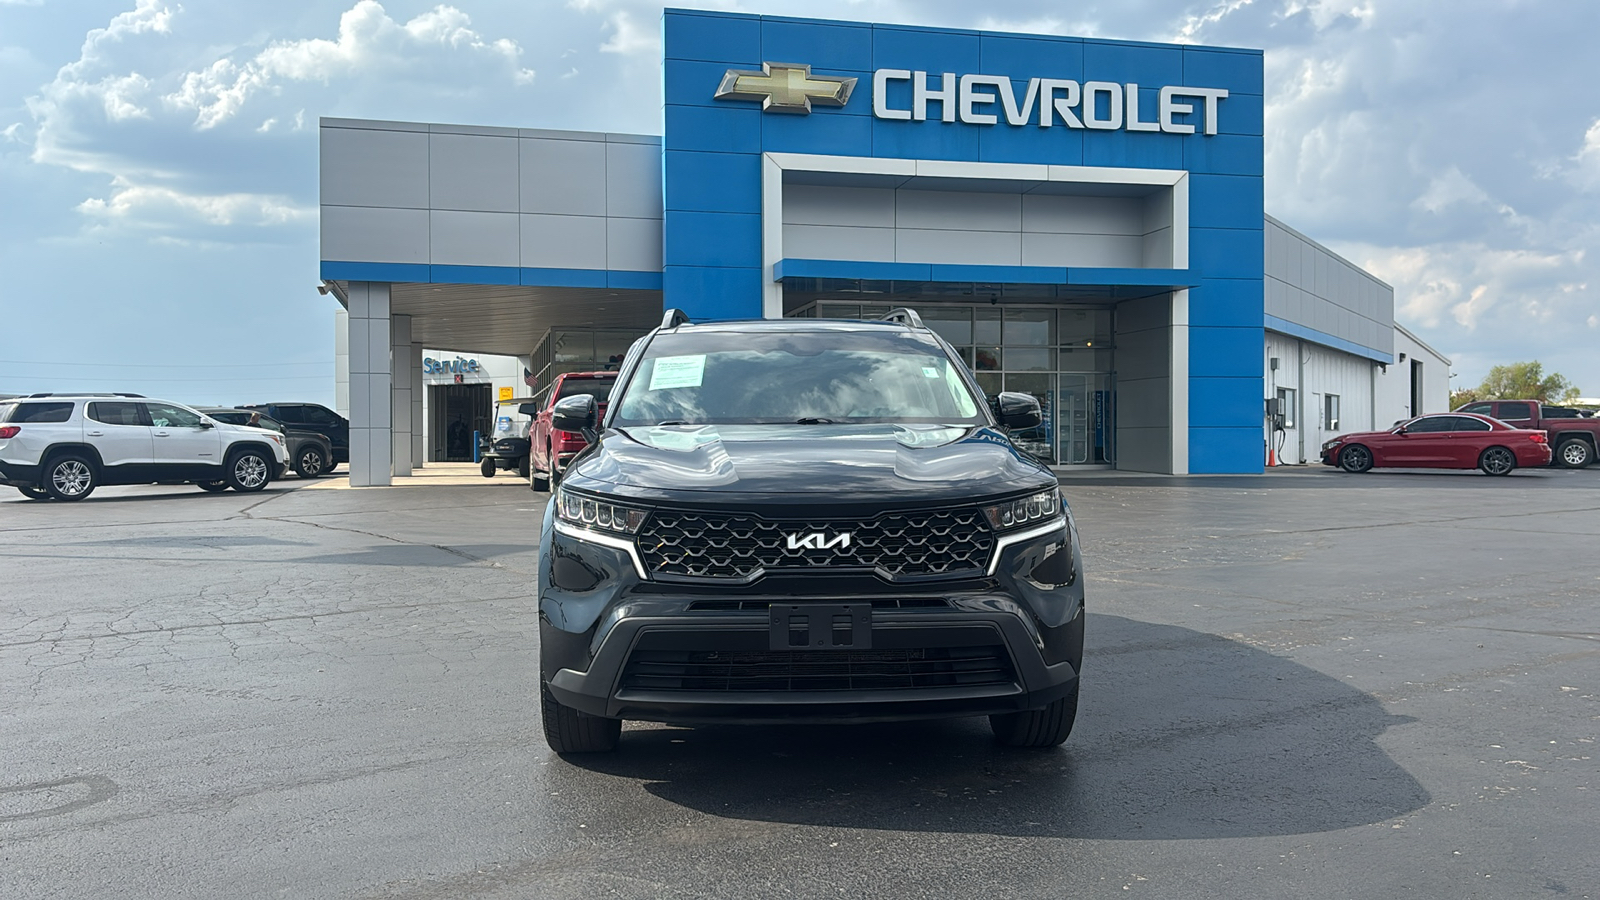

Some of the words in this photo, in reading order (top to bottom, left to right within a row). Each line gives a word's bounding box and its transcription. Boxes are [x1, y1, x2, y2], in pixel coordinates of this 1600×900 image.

[873, 68, 1228, 135] CHEVROLET
[423, 356, 478, 374] Service
[787, 533, 851, 549] KIA
